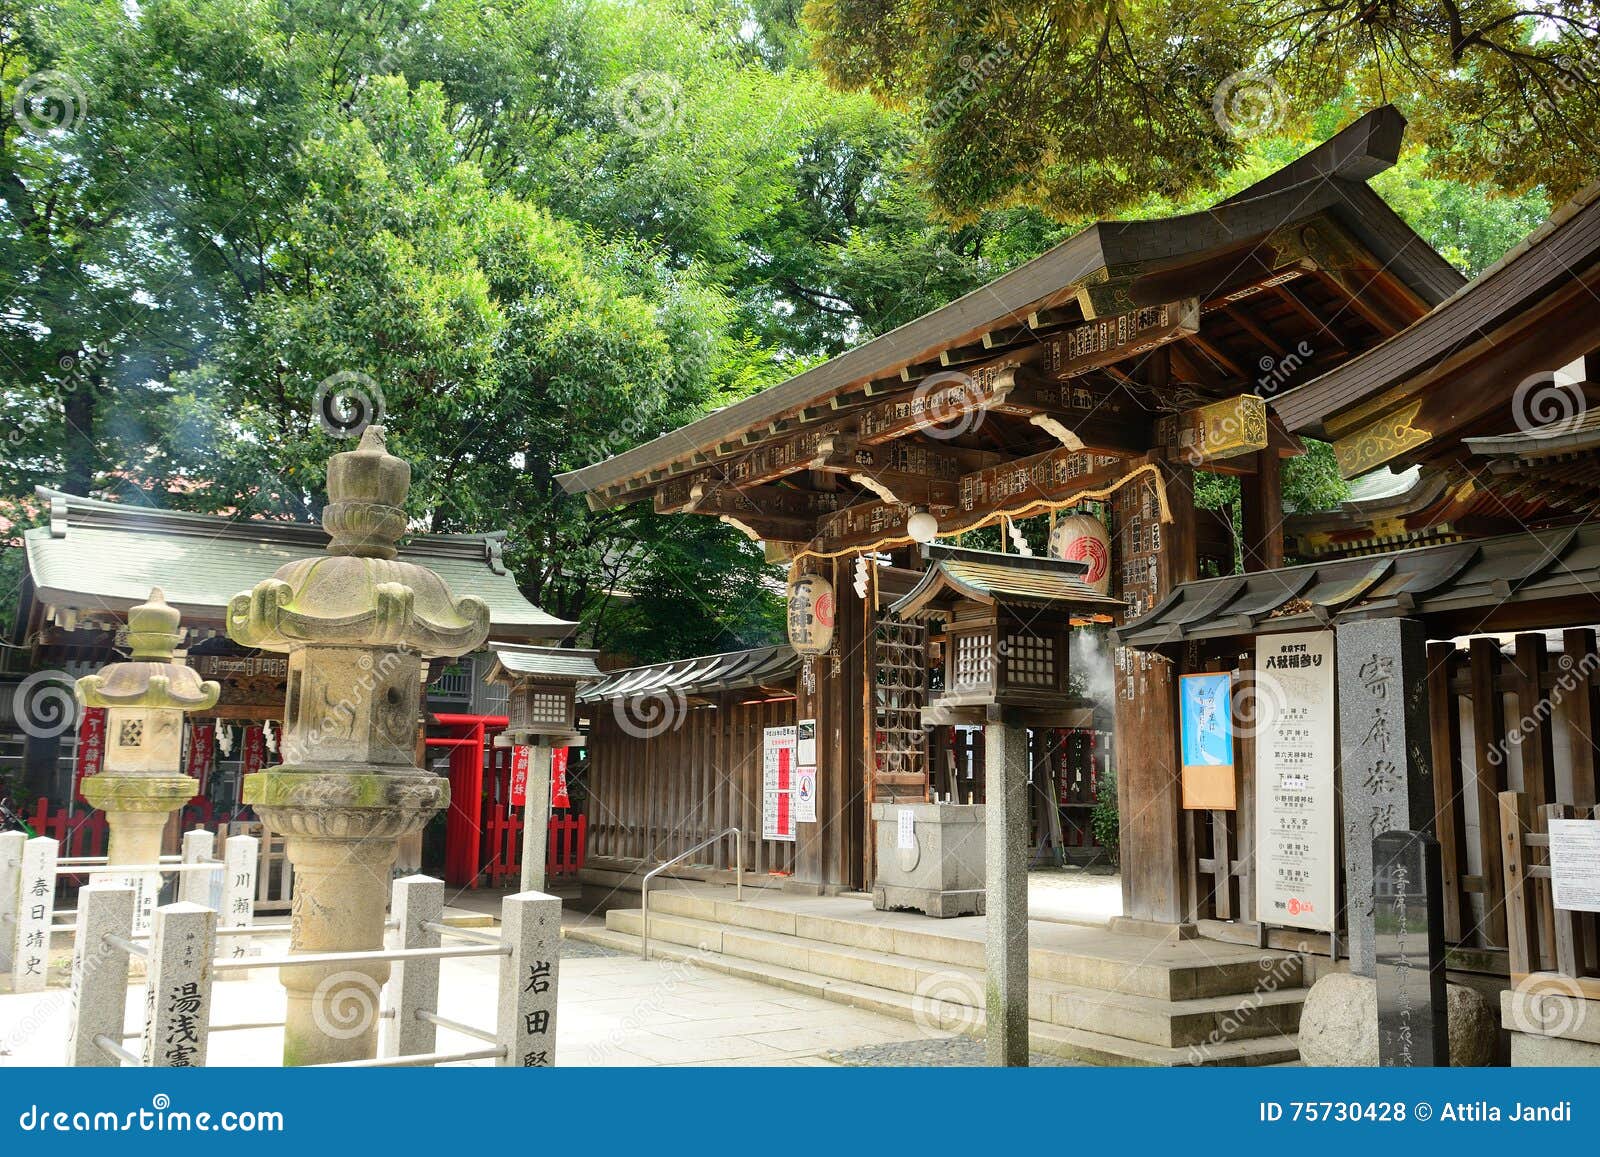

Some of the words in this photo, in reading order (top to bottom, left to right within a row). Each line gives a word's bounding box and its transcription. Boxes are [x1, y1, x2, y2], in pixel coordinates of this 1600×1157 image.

[788, 579, 813, 644] 下谷神社
[25, 877, 50, 975] 春日靖史
